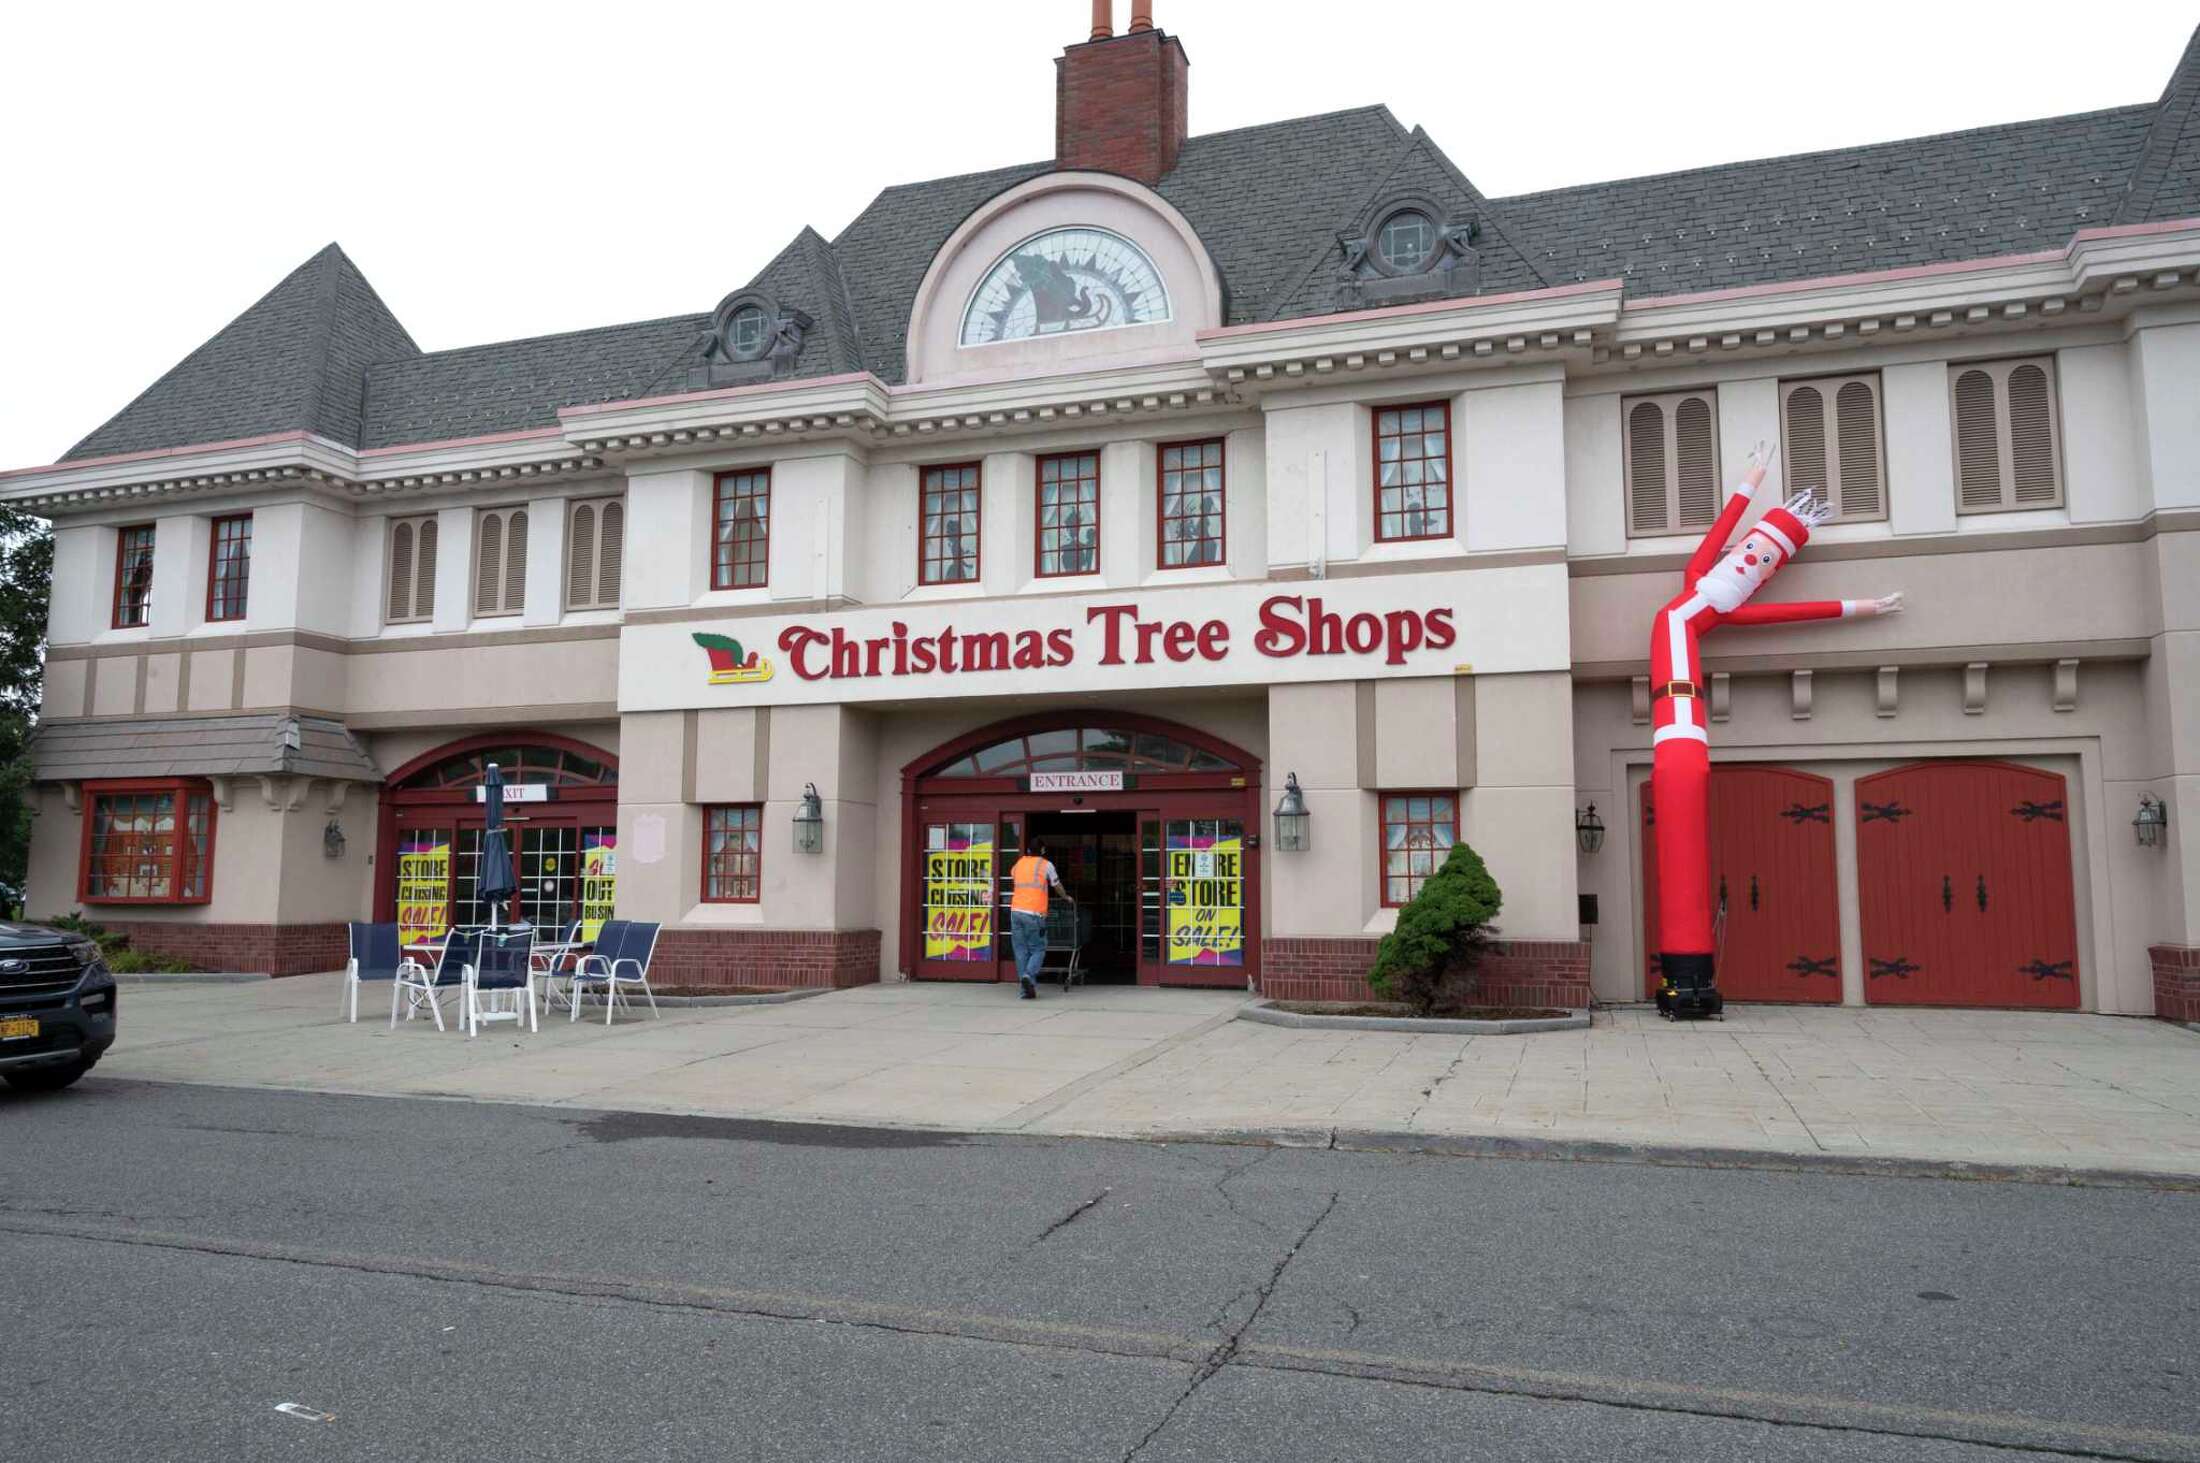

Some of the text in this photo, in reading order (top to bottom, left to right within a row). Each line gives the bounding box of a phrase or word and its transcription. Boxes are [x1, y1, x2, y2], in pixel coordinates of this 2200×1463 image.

[778, 595, 1457, 681] Christmas Tree Shops
[1034, 774, 1120, 788] ENTRANCE
[402, 860, 447, 883] STORE
[931, 858, 990, 884] STORE
[1174, 853, 1238, 877] ENRE
[586, 879, 615, 901] OUT
[1173, 879, 1238, 907] STORE
[400, 905, 446, 933] SALE!
[929, 911, 989, 942] SALE!
[1195, 908, 1217, 923] ON
[1172, 924, 1240, 949] SALE!
